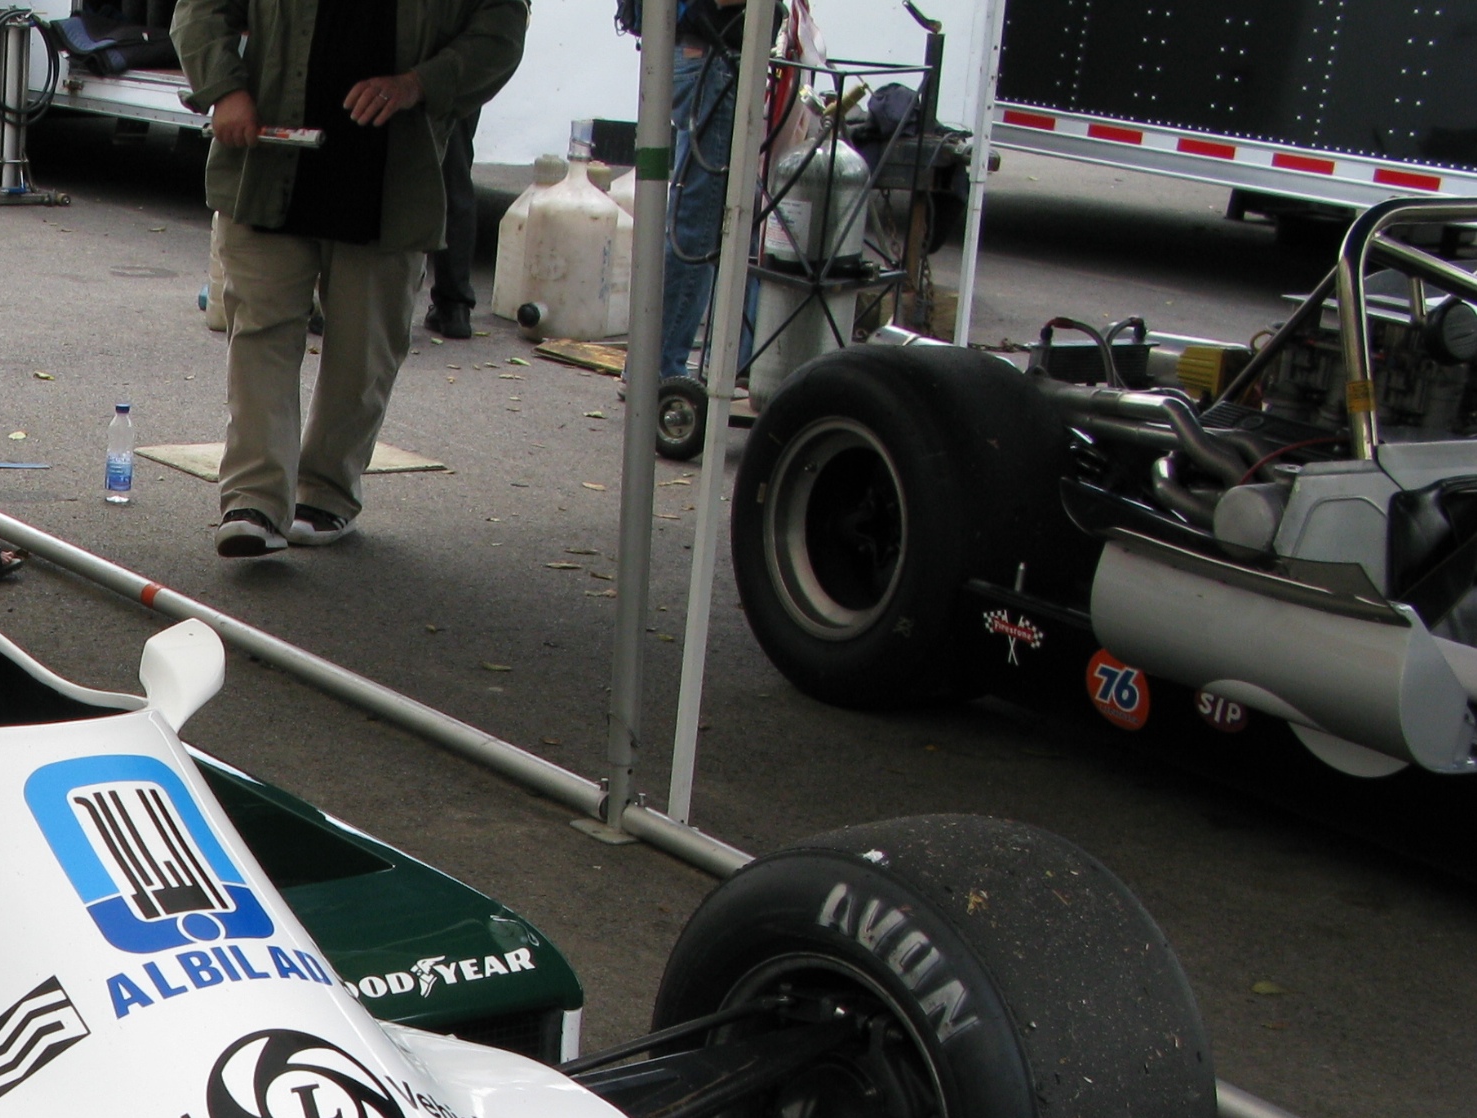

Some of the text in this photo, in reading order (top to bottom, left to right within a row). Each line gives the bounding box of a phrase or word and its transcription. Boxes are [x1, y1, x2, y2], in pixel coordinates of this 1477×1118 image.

[993, 619, 1032, 640] Firestone
[1093, 663, 1140, 712] 76
[106, 945, 333, 1019] ALBILAD
[343, 947, 536, 999] ODYEAR
[818, 883, 980, 1043] AVON
